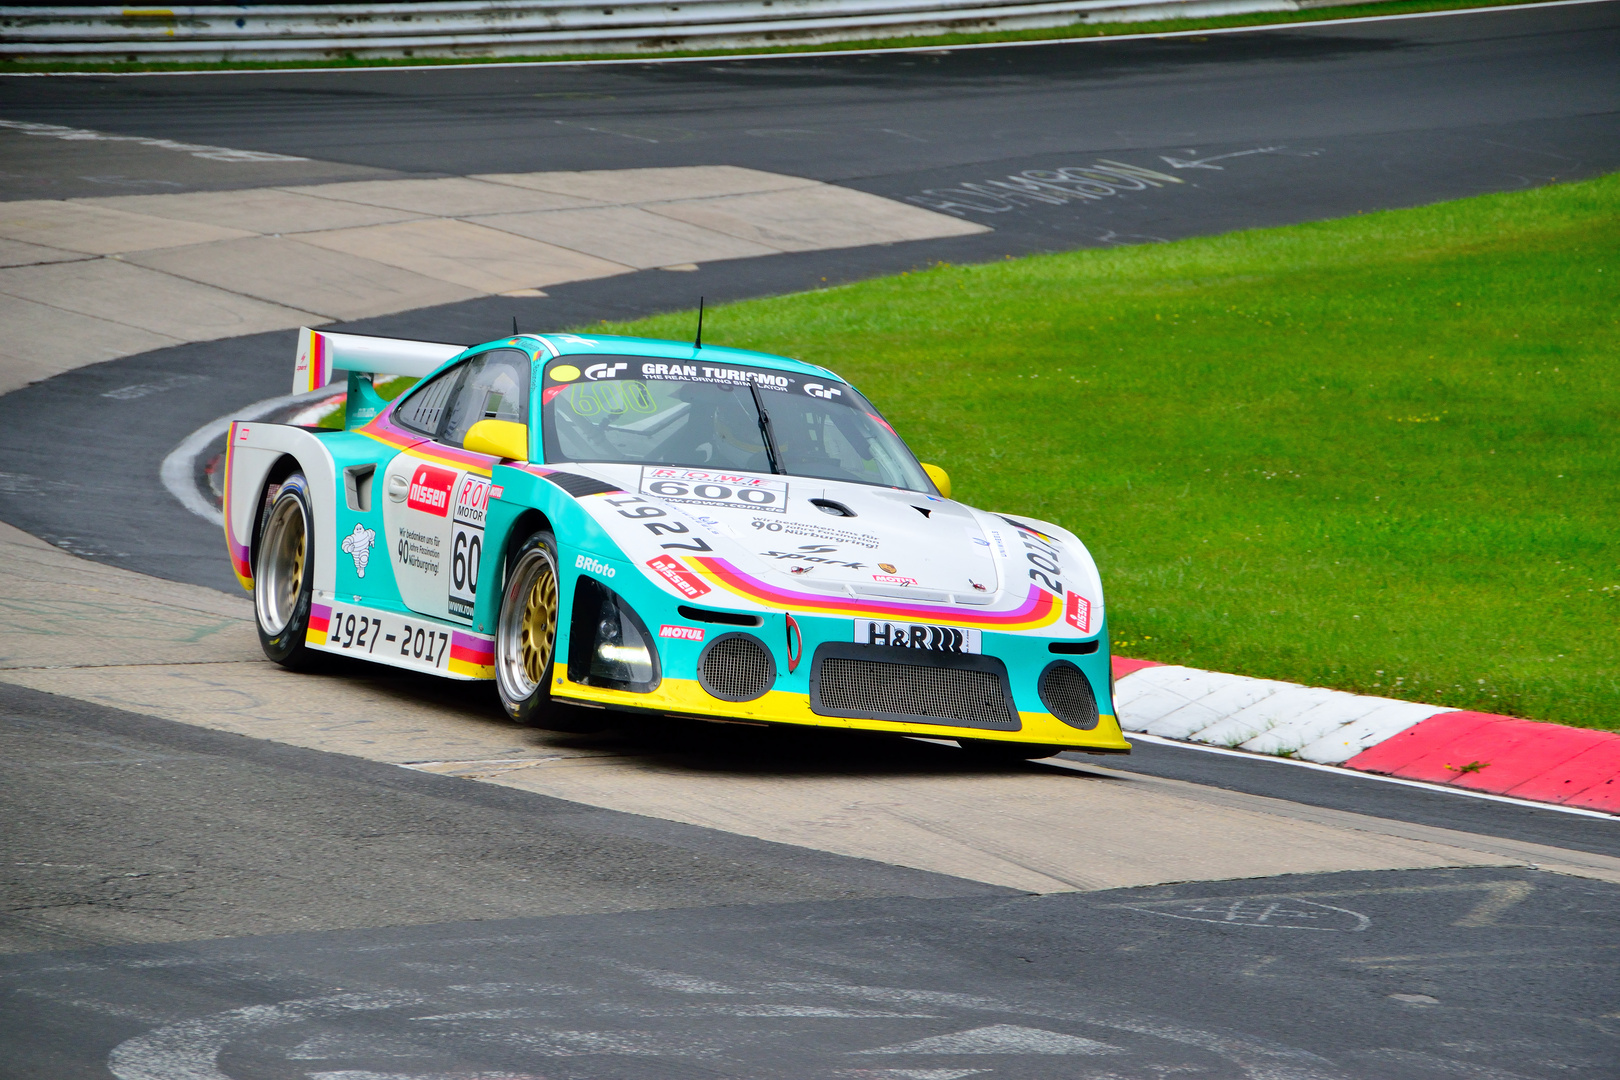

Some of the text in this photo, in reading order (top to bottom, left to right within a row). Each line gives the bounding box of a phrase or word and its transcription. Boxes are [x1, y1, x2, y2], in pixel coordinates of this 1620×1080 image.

[641, 363, 789, 387] GRAN TURISMO
[692, 376, 732, 385] DRIVING
[733, 381, 789, 392] SIMLATOR
[570, 380, 658, 416] 600
[654, 469, 772, 486] ROWE
[409, 472, 447, 509] nissen
[649, 480, 776, 504] 600
[457, 505, 483, 522] MOTOR
[603, 496, 714, 552] 1927
[751, 520, 783, 532] 90
[398, 538, 409, 565] 90
[452, 530, 482, 595] 60
[758, 550, 869, 570] spark
[1017, 530, 1064, 596] 2017
[575, 554, 616, 578] BRfoto
[651, 559, 699, 597] nissen
[874, 574, 917, 585] MOTUL
[1069, 597, 1088, 631] nissen
[659, 625, 703, 641] MOTUL
